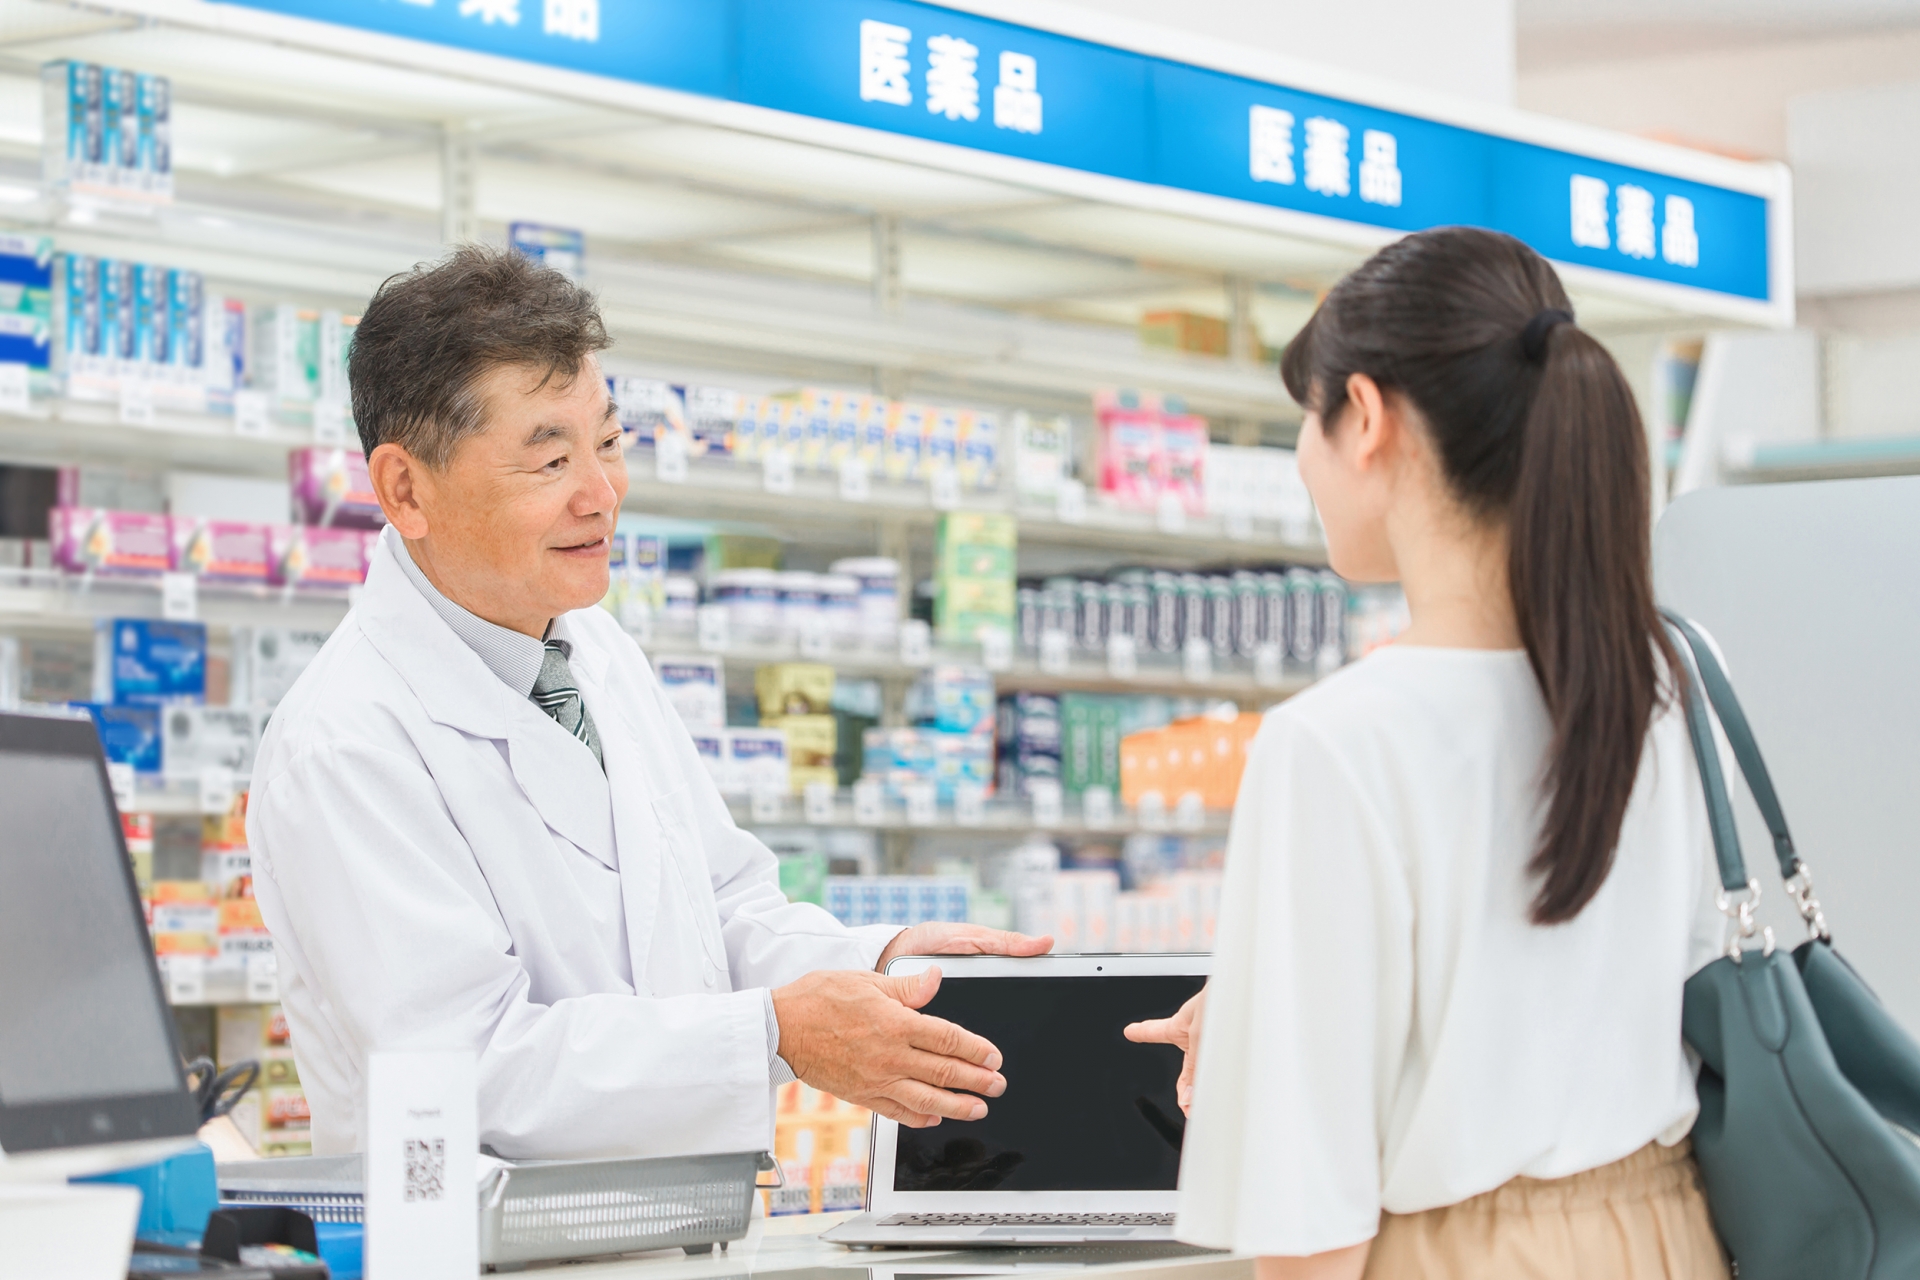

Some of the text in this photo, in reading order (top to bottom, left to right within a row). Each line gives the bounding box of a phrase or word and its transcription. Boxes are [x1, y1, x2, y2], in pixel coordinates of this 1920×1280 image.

[860, 19, 1042, 133] 医薬品
[1249, 105, 1401, 205] 医薬品
[1570, 175, 1698, 266] 医薬品
